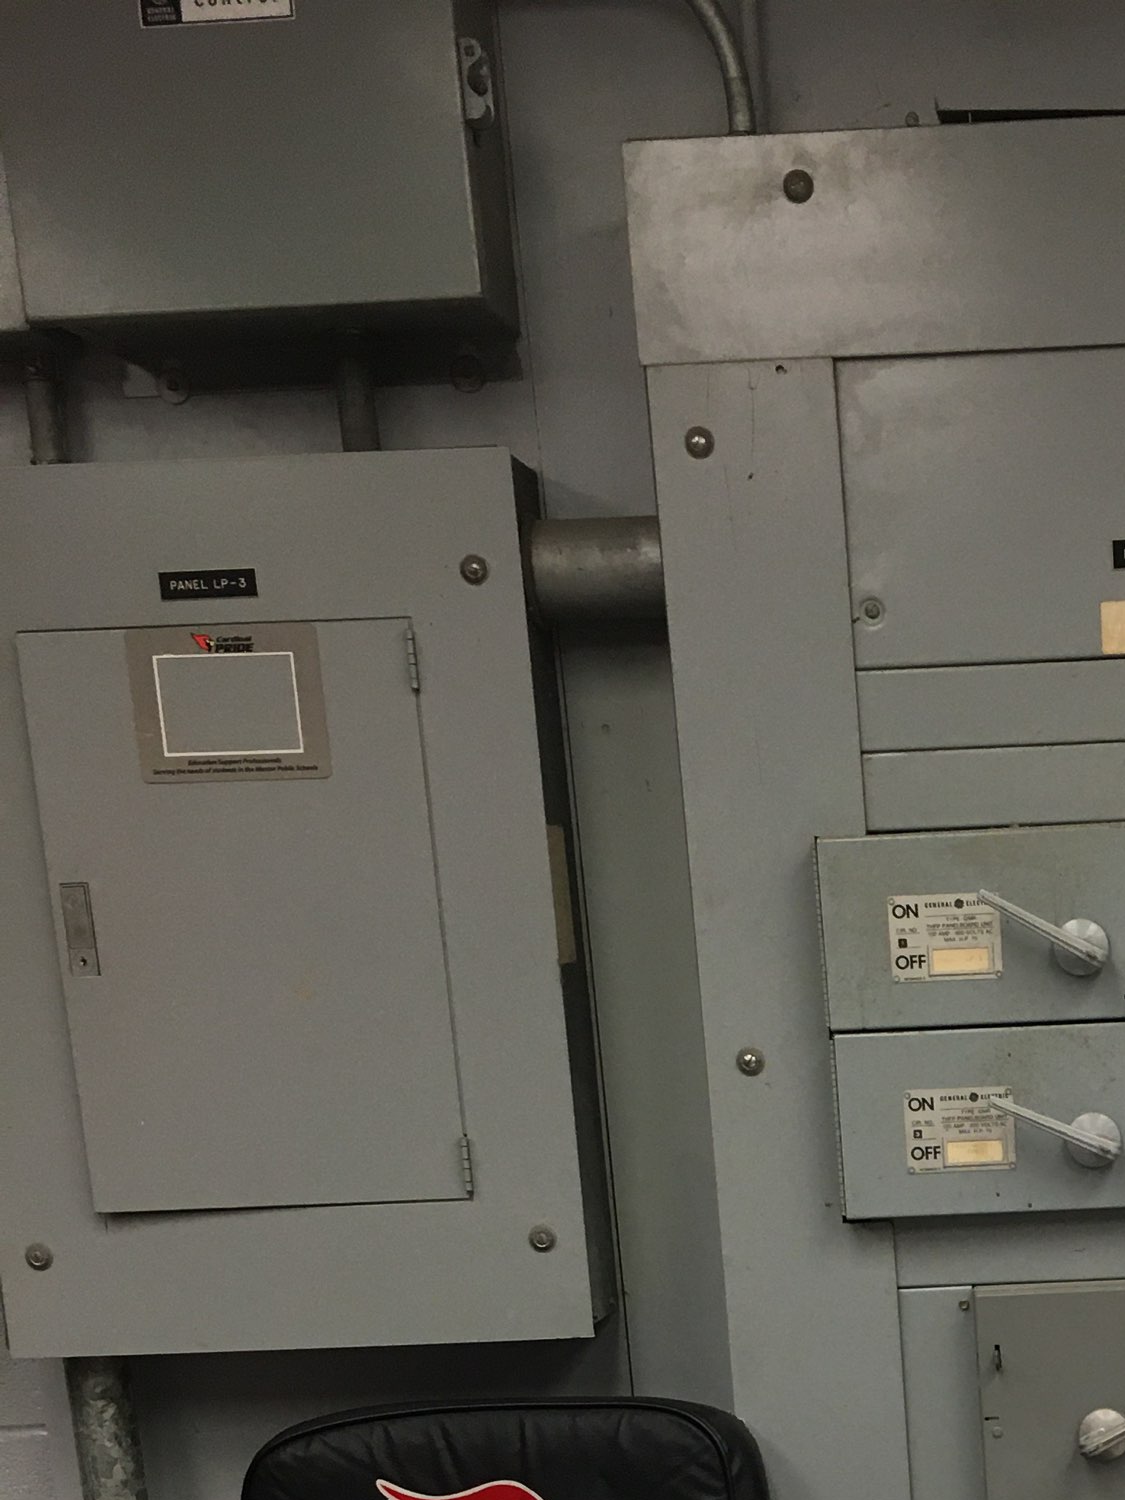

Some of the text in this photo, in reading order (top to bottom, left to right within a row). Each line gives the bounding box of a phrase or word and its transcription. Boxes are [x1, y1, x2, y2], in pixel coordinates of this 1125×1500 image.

[169, 577, 247, 590] PANEL LP-3
[216, 642, 255, 653] PRIDE
[892, 903, 919, 919] ON
[895, 954, 926, 970] OFF
[908, 1097, 935, 1111] ON
[911, 1146, 941, 1160] OFF
